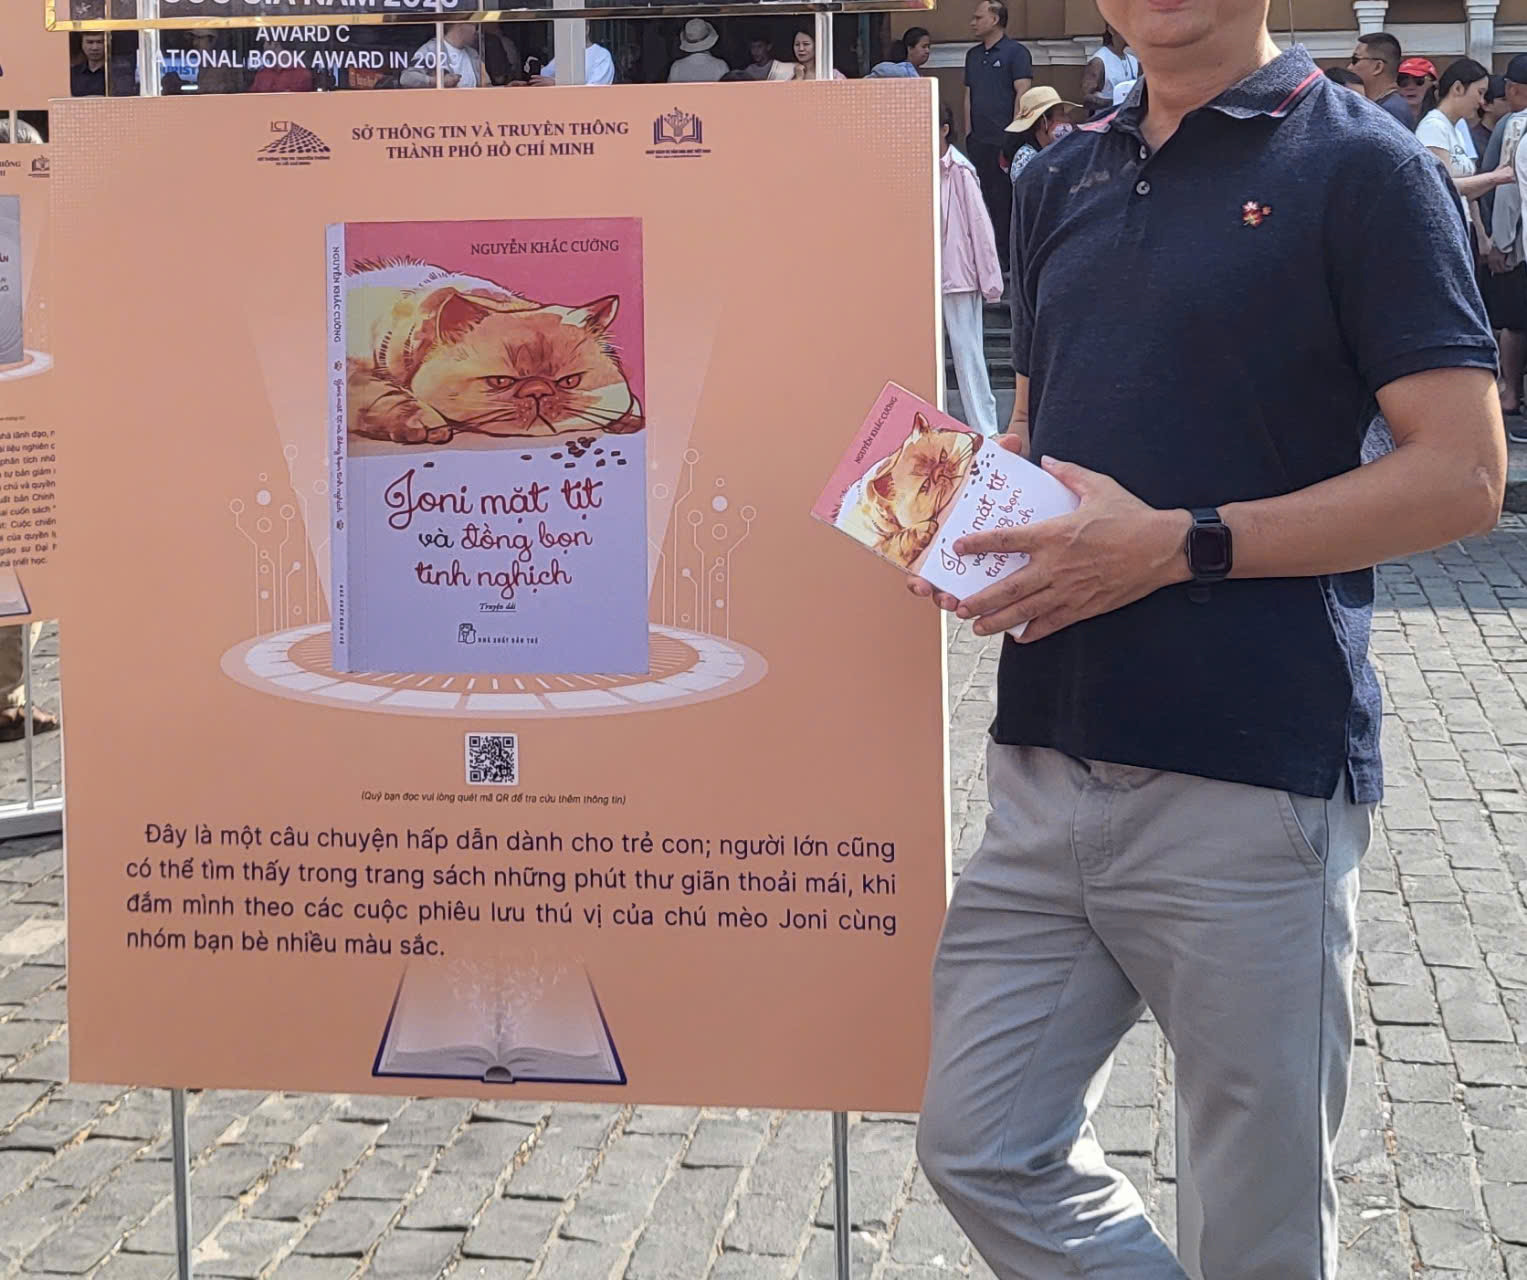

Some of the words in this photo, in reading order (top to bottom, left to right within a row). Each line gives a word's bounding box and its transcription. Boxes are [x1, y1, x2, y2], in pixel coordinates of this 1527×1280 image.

[256, 25, 331, 42] AWARD
[336, 25, 350, 42] C
[136, 49, 243, 69] ATIONAL
[247, 50, 306, 69] BOOK
[311, 50, 384, 69] AWARD
[389, 51, 408, 69] IN
[413, 51, 458, 70] 2023
[352, 124, 373, 140] SỞ
[377, 123, 435, 139] THÔNG
[439, 125, 467, 138] TIN
[471, 122, 494, 137] VÀ
[497, 120, 565, 137] TRUYỀN
[569, 119, 629, 136] THÔNG
[386, 143, 443, 159] THÀNH
[487, 140, 511, 157] HỒ
[515, 139, 545, 156] CHÍ
[550, 142, 594, 155] MINH
[471, 238, 527, 255] NGUYỄN
[530, 238, 568, 253] KHẮC
[571, 239, 619, 252] CƯỜNG
[384, 469, 473, 530] Joni
[480, 481, 550, 524] mặt
[560, 477, 603, 520] tịt
[418, 528, 454, 548] và
[460, 522, 533, 562] đồng
[539, 521, 593, 554] bọn
[415, 559, 471, 586] tinh
[478, 558, 572, 600] nghịch
[144, 824, 187, 848] Đây
[195, 824, 212, 845] là
[220, 826, 262, 850] một
[270, 826, 309, 847] câu
[316, 828, 398, 852] chuyện
[407, 827, 448, 854] hấp
[457, 829, 498, 851] dẫn
[506, 831, 562, 852] dành
[571, 832, 613, 853] cho
[622, 831, 653, 853] trẻ
[662, 835, 711, 858] con;
[719, 833, 785, 860] người
[793, 834, 828, 857] lớn
[837, 836, 896, 863] cũng
[126, 857, 152, 878] có
[159, 858, 193, 879] thể
[201, 859, 234, 881] tìm
[243, 859, 290, 886] thấy
[299, 864, 357, 888] trong
[366, 865, 424, 889] trang
[433, 864, 486, 887] sách
[494, 866, 566, 892] những
[575, 867, 626, 893] phút
[635, 870, 673, 890] thư
[681, 870, 730, 895] giãn
[738, 870, 796, 893] thoải
[805, 872, 853, 897] mái,
[862, 874, 896, 895] khi
[126, 892, 172, 914] đắm
[182, 893, 234, 915] mình
[244, 896, 294, 917] theo
[304, 896, 343, 918] các
[354, 898, 408, 921] cuộc
[418, 899, 480, 925] phiêu
[491, 902, 525, 922] lưu
[536, 901, 572, 923] thú
[583, 903, 602, 928] vị
[612, 903, 654, 926] của
[665, 904, 706, 927] chú
[717, 906, 768, 928] mèo
[778, 908, 827, 930] Joni
[838, 909, 897, 936] cùng
[126, 928, 186, 950] nhóm
[194, 930, 234, 951] bạn
[242, 930, 268, 951] bè
[276, 930, 337, 953] nhiều
[345, 932, 392, 955] màu
[400, 934, 444, 956] sắc.
